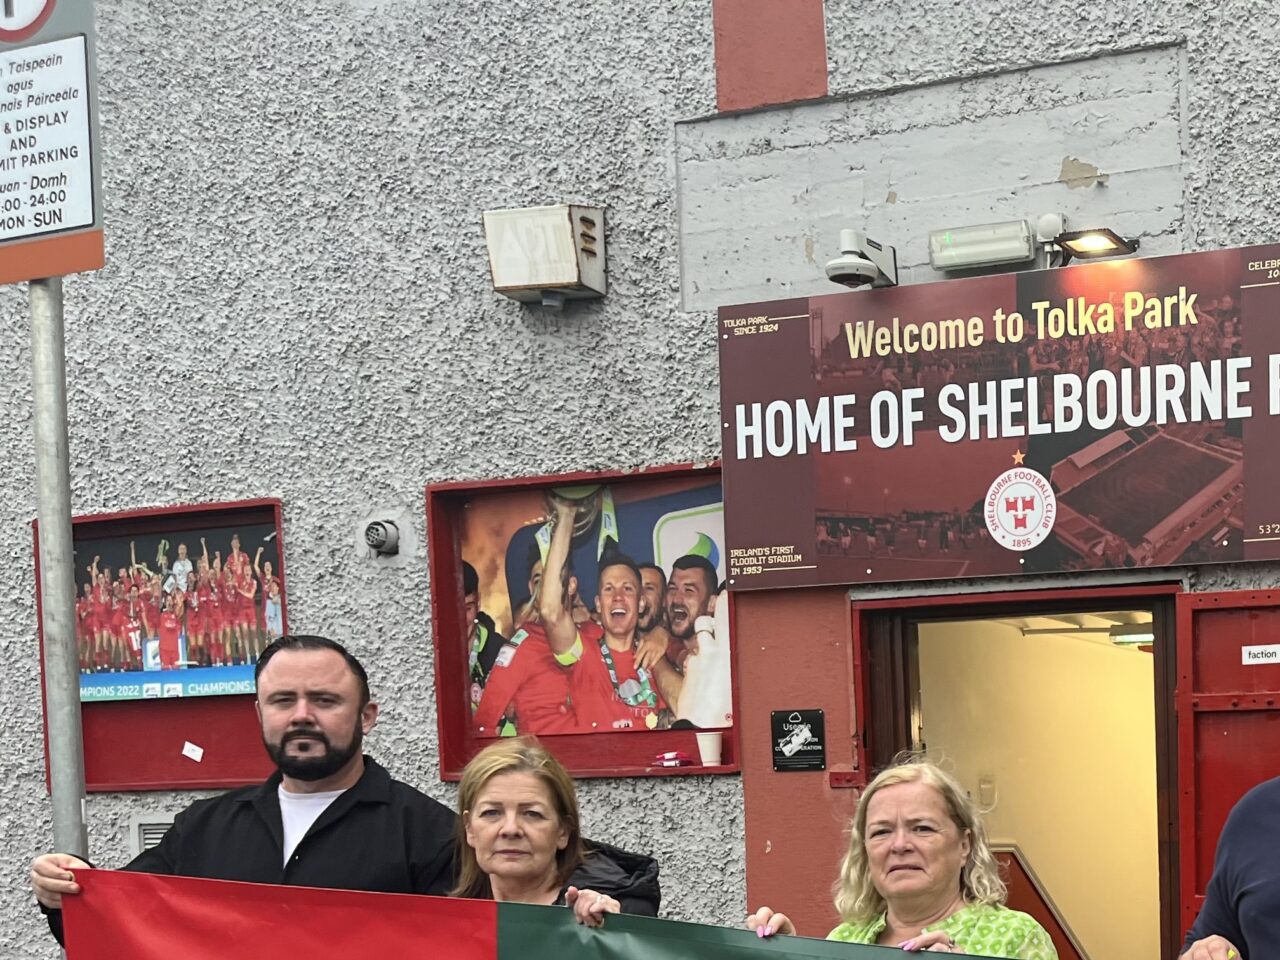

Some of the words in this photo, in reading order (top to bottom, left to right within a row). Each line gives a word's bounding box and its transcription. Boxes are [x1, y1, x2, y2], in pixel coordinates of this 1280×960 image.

[7, 79, 34, 95] agus
[4, 122, 12, 135] &
[16, 110, 69, 133] DISPLAY
[10, 135, 37, 152] AND
[21, 145, 79, 168] PARKING
[30, 172, 67, 190] Domh
[30, 189, 66, 207] 24:00
[33, 208, 62, 228] SUN
[723, 319, 746, 328] TOLKA
[747, 315, 768, 325] PARK
[734, 326, 757, 336] SINCE
[759, 323, 779, 333] 1924
[845, 316, 984, 359] Welcome
[992, 307, 1024, 344] to
[1031, 296, 1115, 340] Tolka
[1124, 286, 1199, 332] Park
[735, 394, 858, 460] HOME
[870, 387, 925, 449] OF
[938, 356, 1253, 443] SHELBOURNE
[988, 474, 1012, 531] SHELBOURNE
[1014, 471, 1051, 501] FOOTBALL
[1042, 503, 1053, 529] CLUB
[1011, 537, 1032, 548] 1895
[730, 547, 770, 558] IRELAND'S
[771, 545, 795, 555] FIRST
[730, 556, 766, 566] FLOODLIT
[768, 554, 802, 564] STADIUM
[731, 567, 741, 576] IN
[742, 566, 763, 575] 1953
[1248, 649, 1277, 660] faction
[117, 685, 139, 697] 2022
[188, 680, 251, 695] CHAMPIONS
